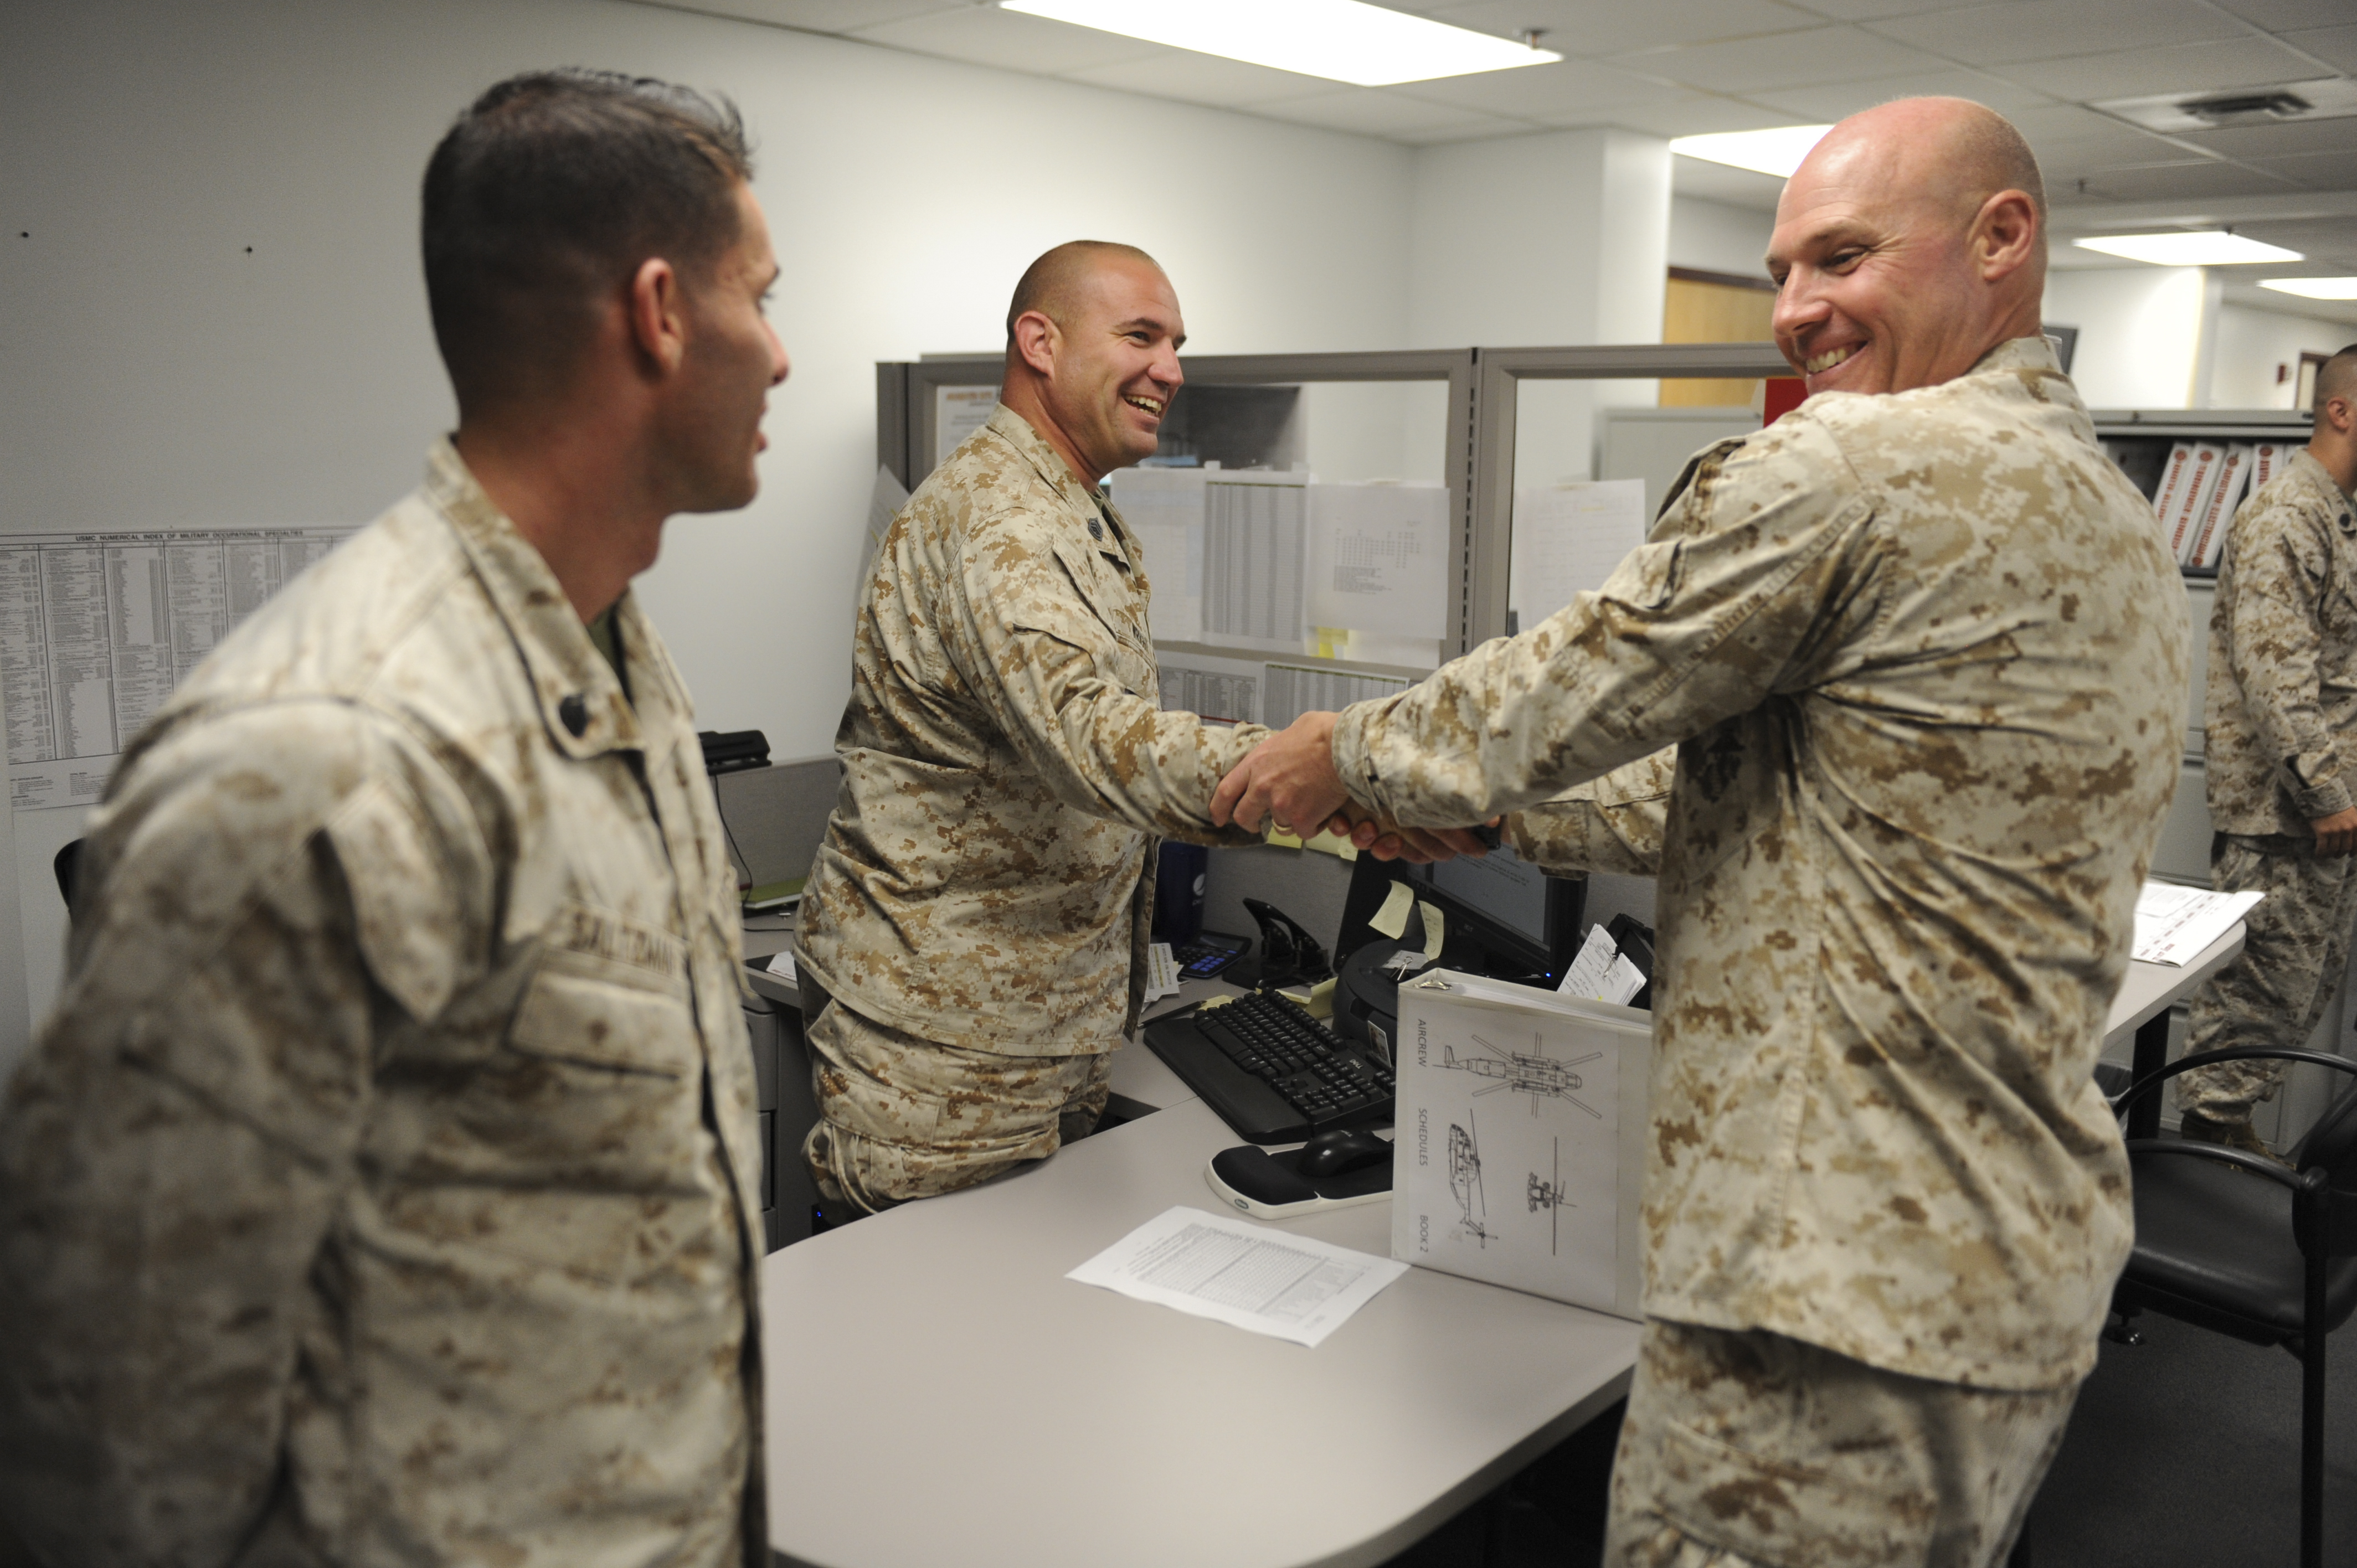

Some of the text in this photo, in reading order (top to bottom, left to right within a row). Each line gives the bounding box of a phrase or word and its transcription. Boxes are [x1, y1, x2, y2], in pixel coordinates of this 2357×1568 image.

[1418, 1018, 1427, 1067] AIRCREW
[1349, 1059, 1363, 1070] DELL
[1418, 1108, 1428, 1166] SCHEDULES
[1419, 1214, 1429, 1244] BOOK
